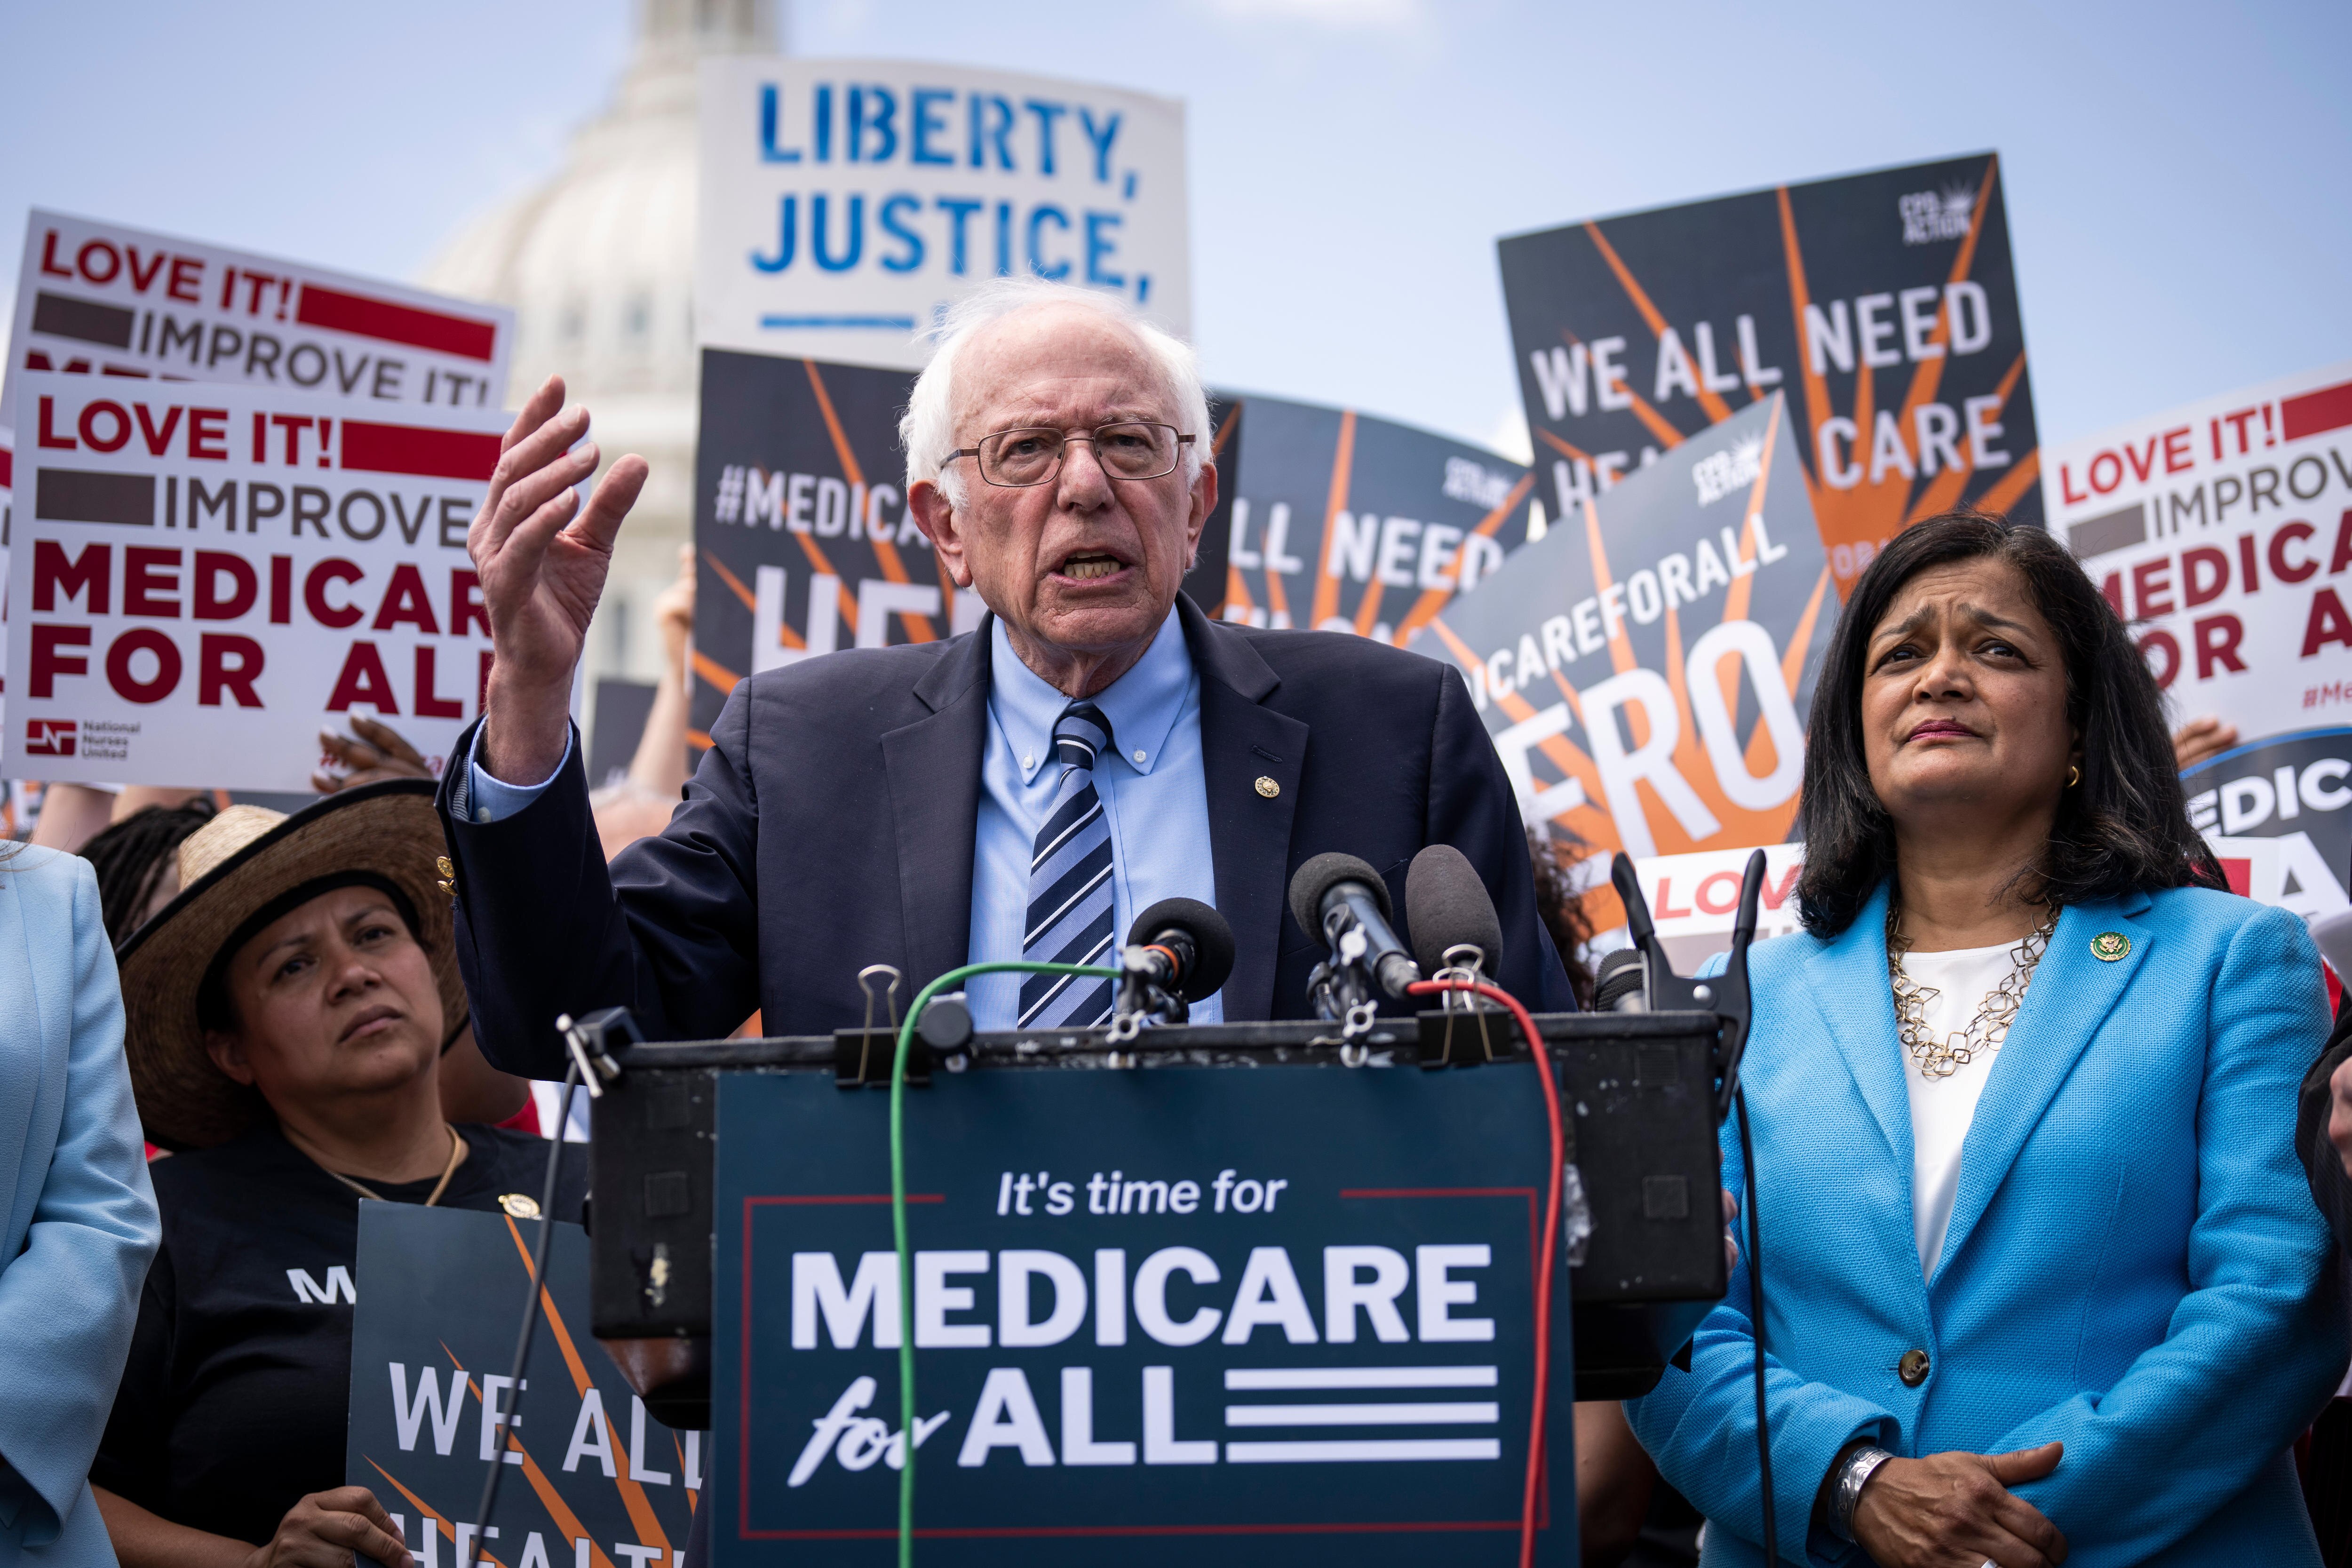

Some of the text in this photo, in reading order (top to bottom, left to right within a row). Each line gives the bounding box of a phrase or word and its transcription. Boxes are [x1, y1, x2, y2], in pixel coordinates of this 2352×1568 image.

[758, 81, 1140, 200] LIBERTY,
[40, 229, 293, 323] LOVE IT!
[748, 192, 1153, 305] JUSTICE,
[138, 310, 405, 399] IMPROVE
[1530, 281, 1992, 420] WE ALL NEED
[38, 395, 332, 468] LOVE IT!
[1818, 394, 2010, 489] CARE
[2060, 402, 2276, 506] LOVE IT!
[165, 476, 471, 548] IMPROVE
[1328, 510, 1503, 593] NEED
[29, 623, 265, 708] FOR
[82, 734, 128, 746] Nurses
[82, 748, 127, 760] United
[83, 720, 141, 734] National
[996, 1169, 1287, 1217] It's time for
[791, 1243, 1495, 1351] MEDICARE
[389, 1361, 527, 1465] WE
[787, 1365, 1219, 1487] for ALL
